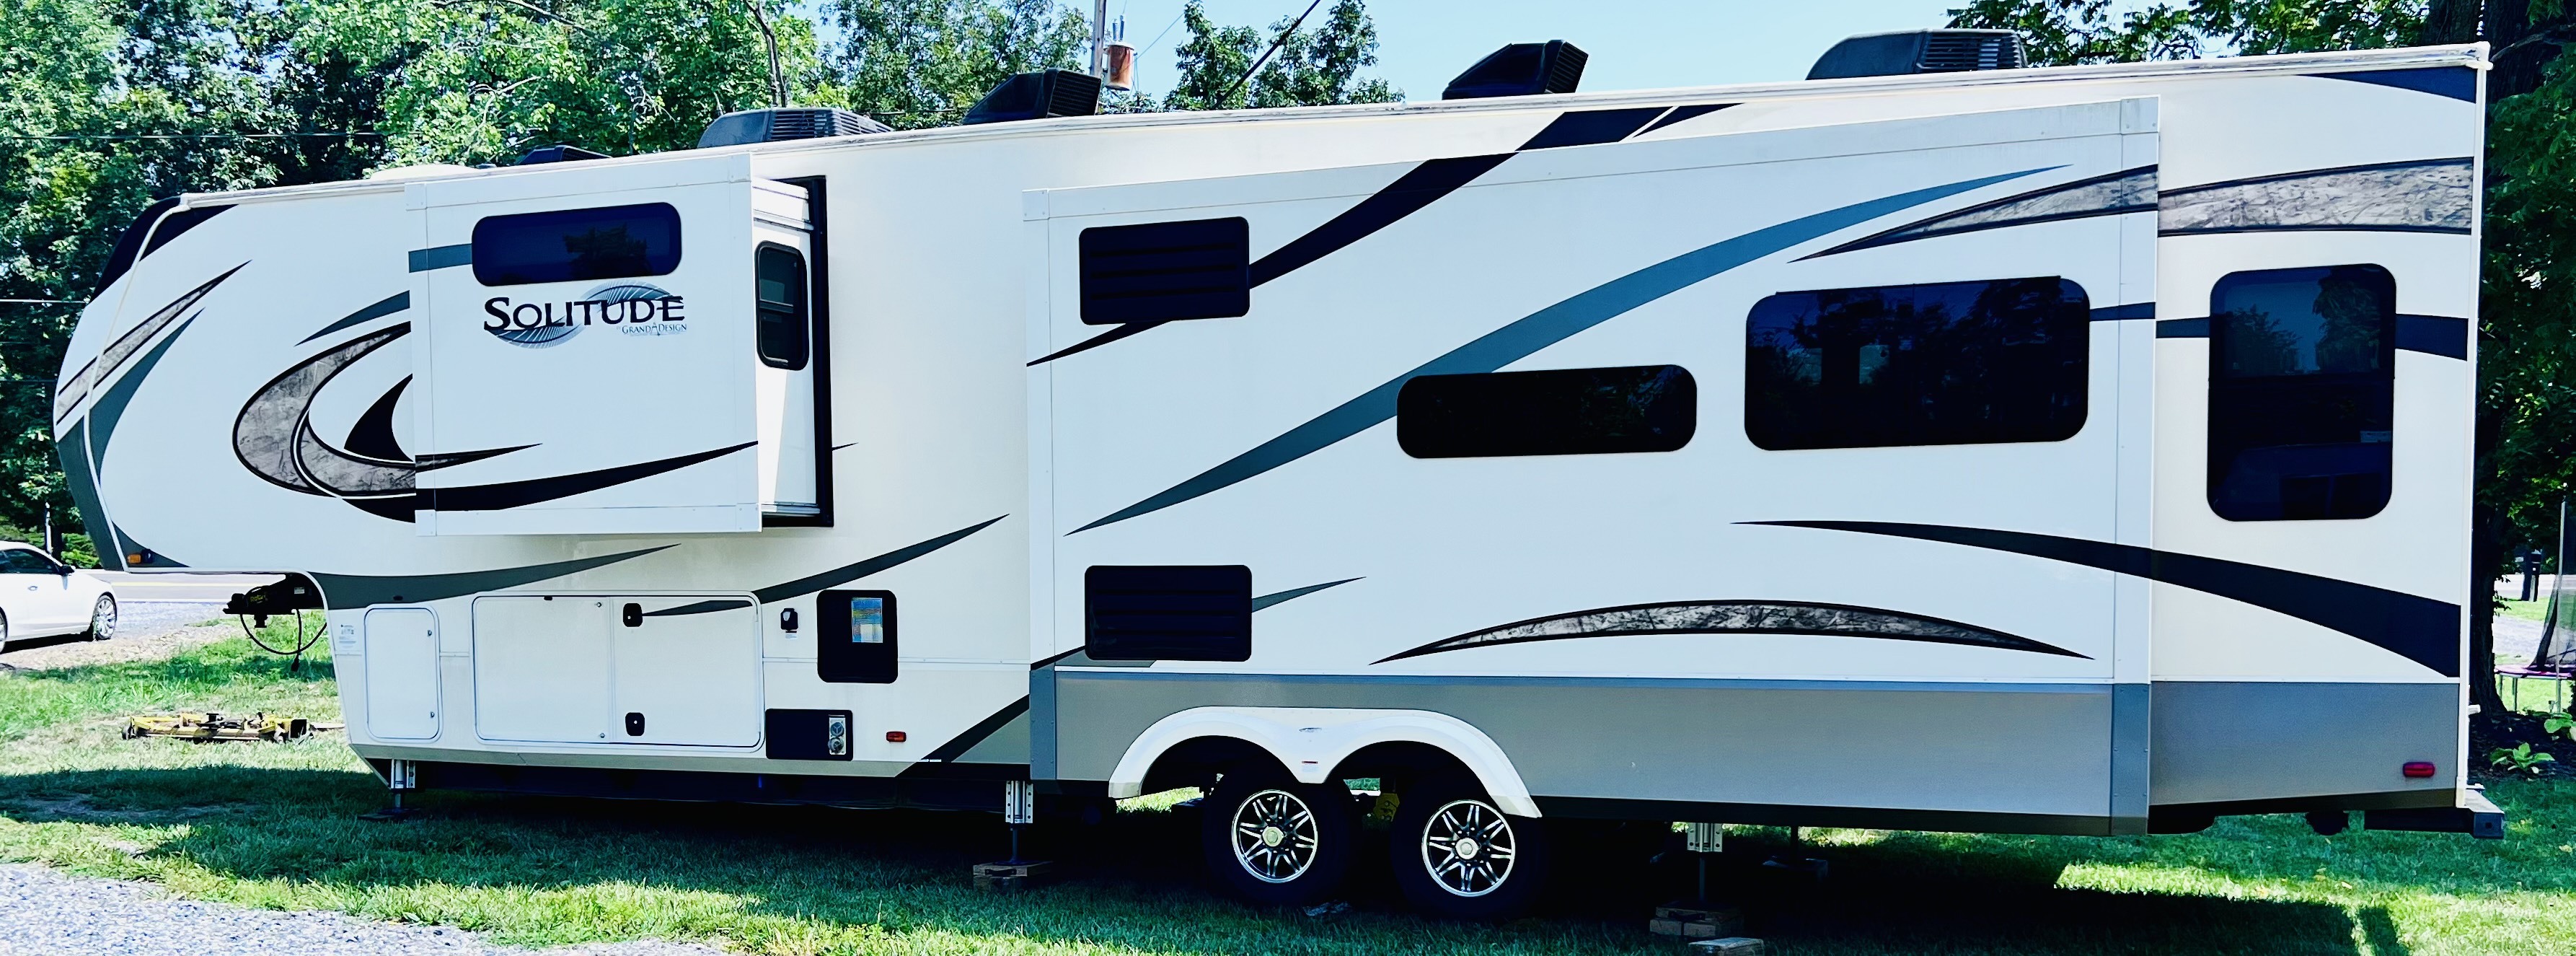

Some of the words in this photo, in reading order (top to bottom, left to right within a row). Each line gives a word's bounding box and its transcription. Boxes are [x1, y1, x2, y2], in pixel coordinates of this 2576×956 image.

[484, 296, 685, 330] SOLITUDE
[622, 325, 651, 334] GRAND
[658, 323, 687, 333] DESIGN
